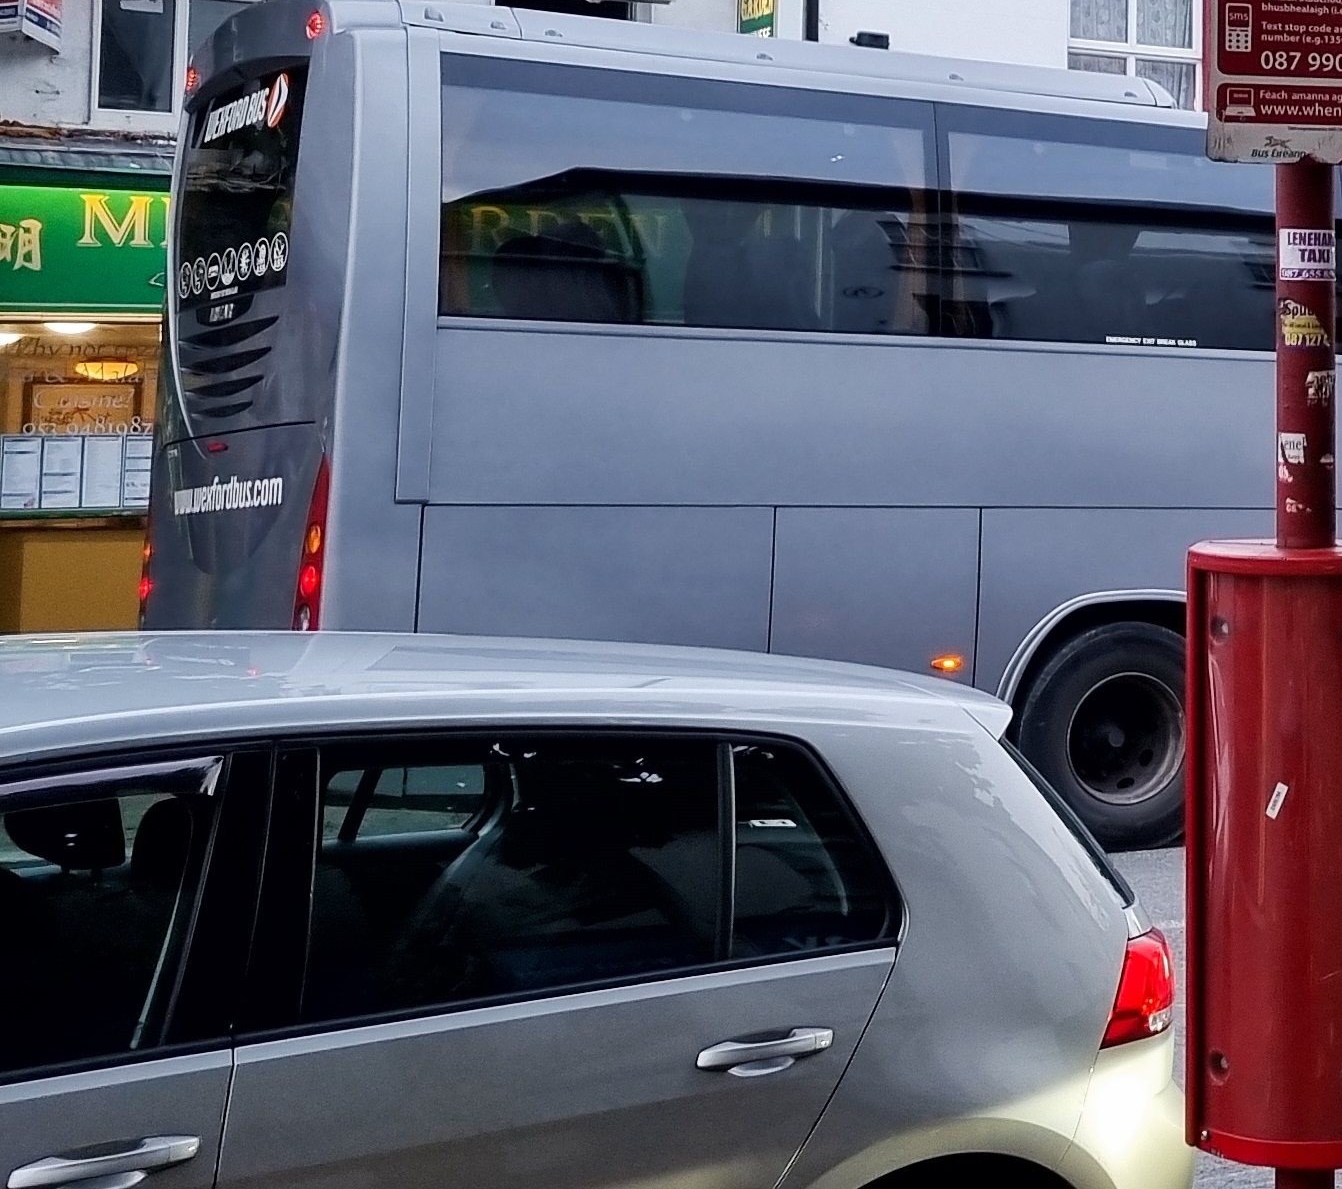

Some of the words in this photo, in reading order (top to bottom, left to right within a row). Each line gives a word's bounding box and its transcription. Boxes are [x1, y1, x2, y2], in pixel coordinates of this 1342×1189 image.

[1229, 13, 1249, 21] sms
[1261, 21, 1282, 31] Text
[1284, 23, 1306, 33] stop
[1308, 24, 1332, 33] code
[1261, 33, 1300, 43] number
[1260, 51, 1302, 71] 087
[1291, 92, 1330, 101] amanna
[204, 96, 250, 143] WEXFORD
[246, 87, 270, 126] BUS
[1251, 148, 1269, 158] Bus
